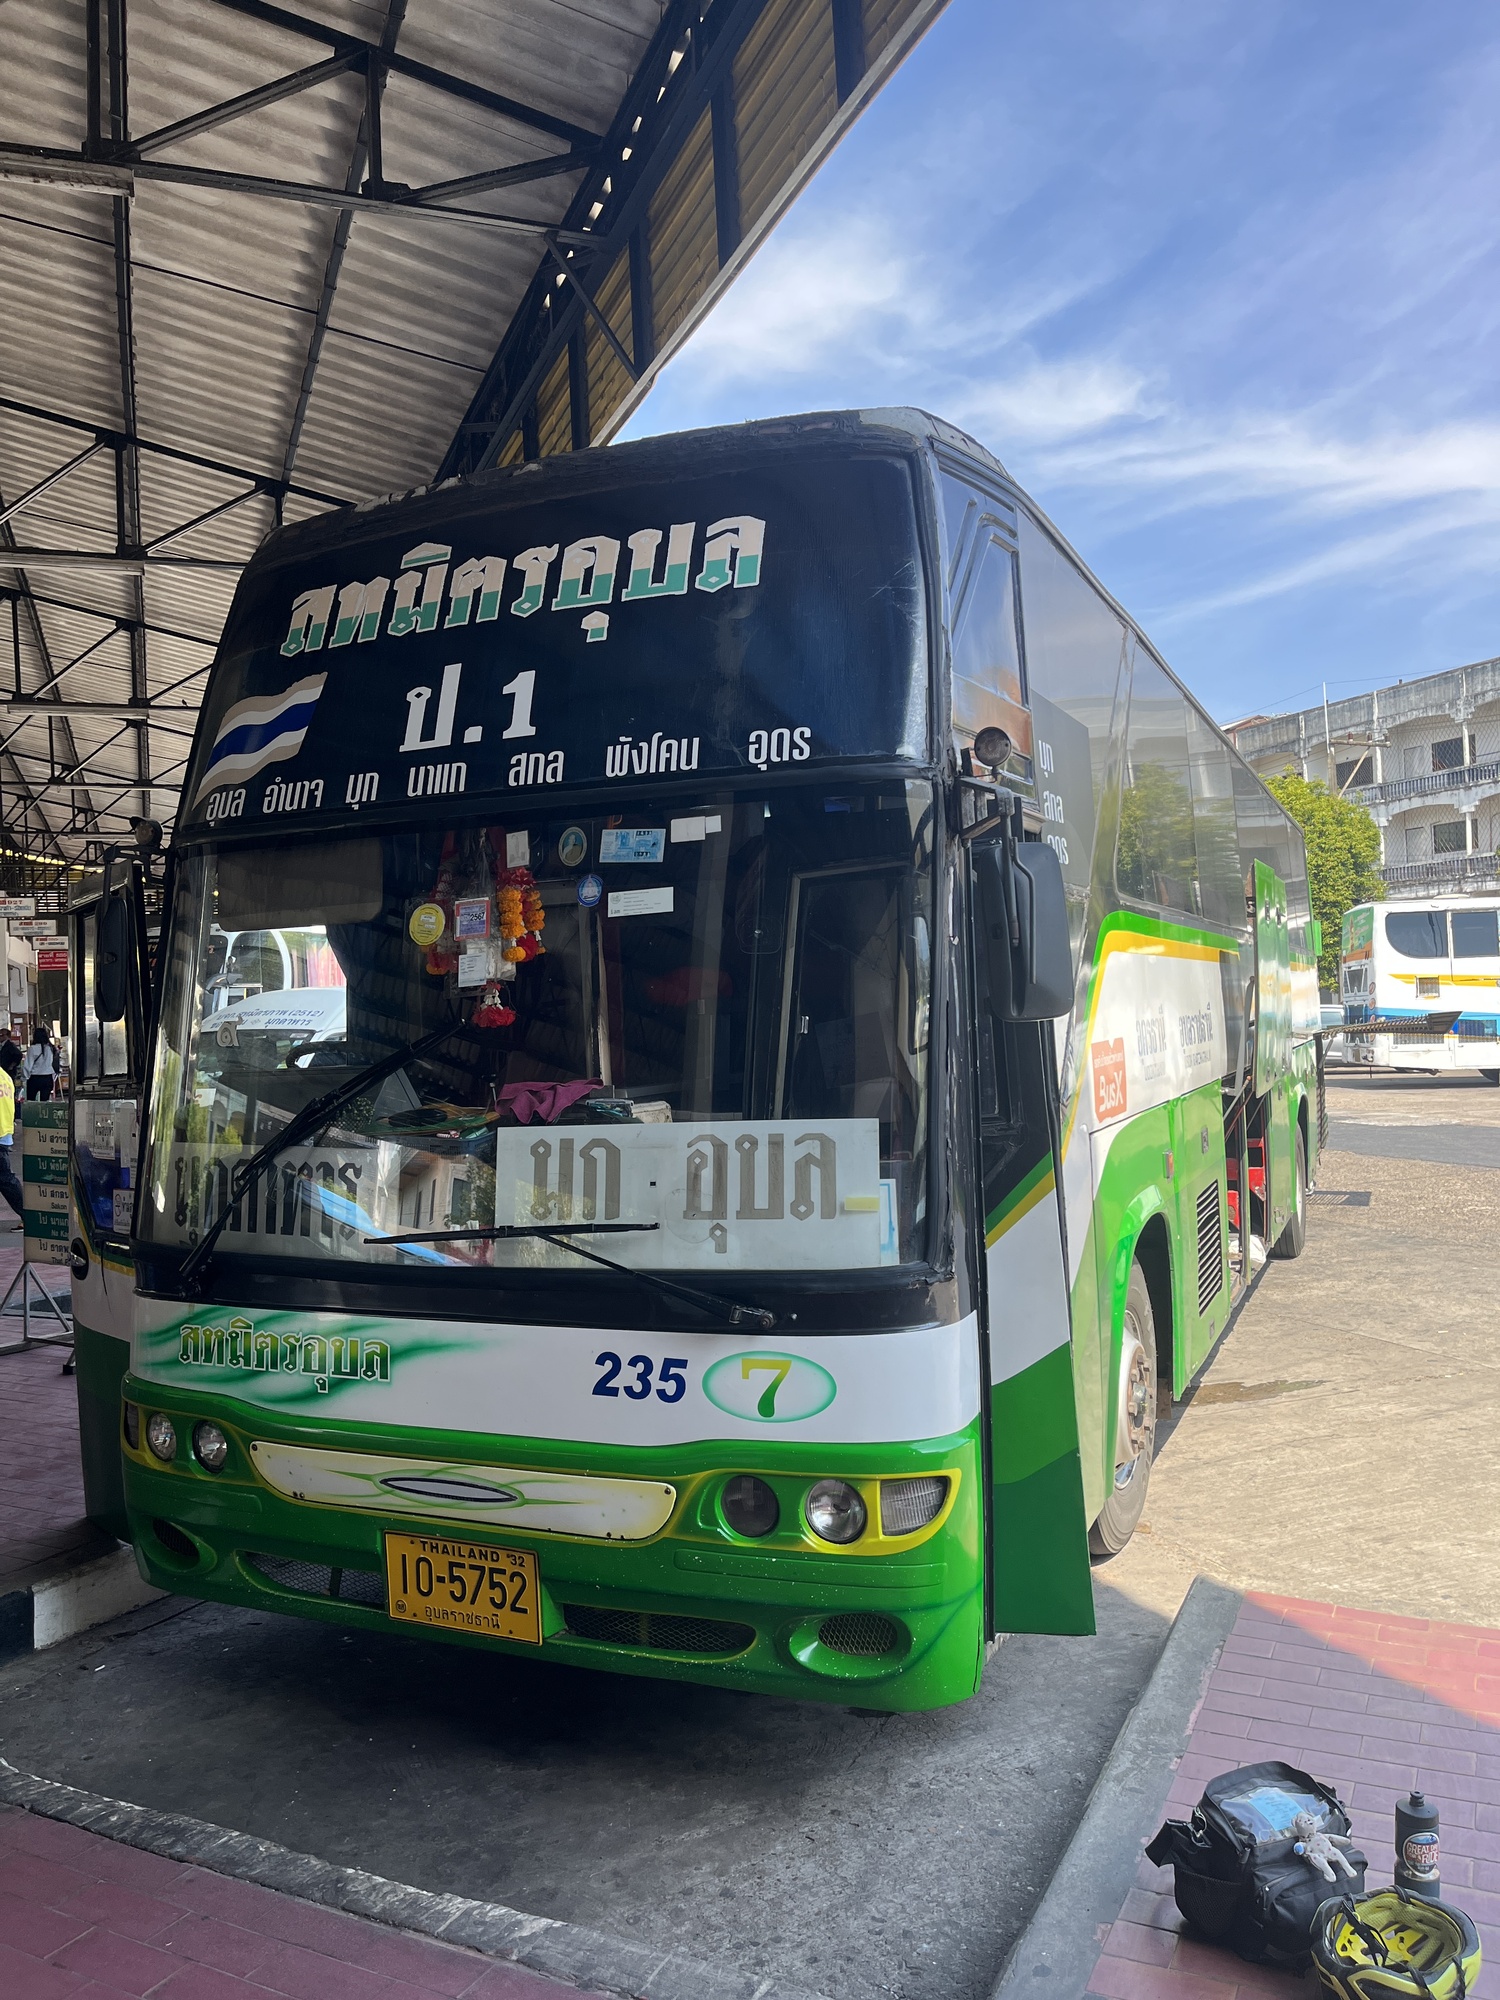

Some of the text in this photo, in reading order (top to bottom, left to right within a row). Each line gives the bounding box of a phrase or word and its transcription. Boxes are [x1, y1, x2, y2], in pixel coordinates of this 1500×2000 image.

[279, 515, 767, 658] สหมิตรอุบล
[206, 726, 812, 828] อุบล อำนาจ มุก นาแก สกล พังโคน อุดร
[1038, 740, 1054, 778] มุก
[1043, 790, 1064, 824] สกล
[683, 1133, 836, 1254] อุบล
[179, 1316, 391, 1394] สหมิตรอุบล
[592, 1351, 792, 1418] 235 7
[420, 1540, 501, 1563] THAILAND
[401, 1553, 530, 1615] 10-5752
[424, 1605, 501, 1630] อุบลราชธานี
[1406, 1842, 1430, 1855] GREAT
